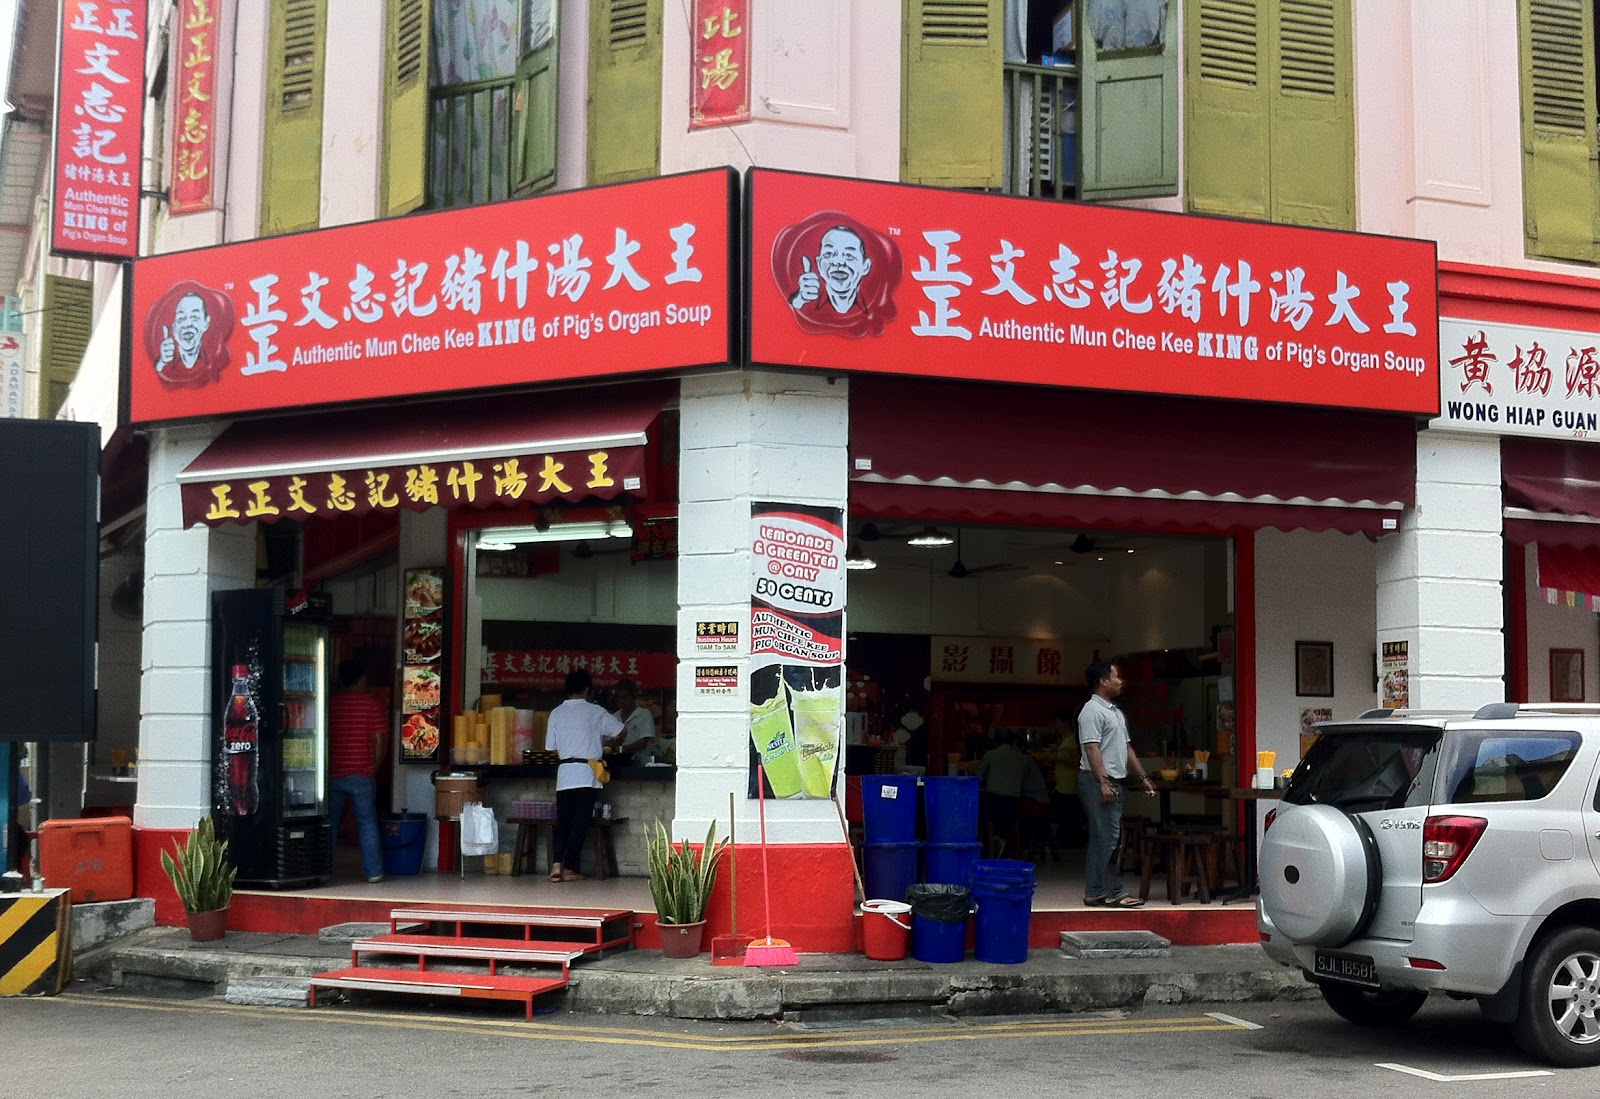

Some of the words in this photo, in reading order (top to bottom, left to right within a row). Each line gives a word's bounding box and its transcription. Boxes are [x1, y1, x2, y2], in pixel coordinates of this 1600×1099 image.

[65, 187, 129, 207] Authentic
[64, 211, 108, 231] KING
[113, 220, 128, 232] of
[292, 341, 362, 366] Authentic
[365, 337, 398, 358] Mun
[401, 332, 440, 354] Chee
[444, 328, 475, 349] Kee
[477, 316, 537, 347] KING
[542, 317, 560, 339] of
[564, 313, 604, 340] Pig's
[608, 309, 660, 335] Organ
[665, 303, 712, 327] Soup
[978, 316, 1065, 344] Authentic
[1070, 324, 1107, 347] Mun
[1112, 327, 1156, 351] Chee
[1161, 331, 1194, 354] Kee
[1197, 332, 1258, 361] KING
[1265, 341, 1283, 361] of
[1286, 342, 1327, 368] Pig's
[1330, 346, 1379, 372] Organ
[1384, 350, 1426, 377] Soup
[1448, 401, 1499, 423] WONG
[1506, 406, 1545, 426] HIAP
[1552, 410, 1597, 431] GUAN
[205, 452, 615, 520] 正正文志記豬什湯大王
[761, 525, 833, 553] LEMONADE
[753, 540, 765, 555] &
[767, 544, 811, 565] GREEN
[811, 552, 838, 569] TEA
[768, 560, 781, 574] @
[782, 563, 820, 582] ONLY
[756, 577, 777, 596] 50
[754, 613, 812, 639] AUTHENTIC
[754, 626, 776, 637] MUN
[777, 631, 804, 645] CHEE
[806, 641, 828, 651] KEE
[755, 639, 772, 650] PIG
[774, 640, 809, 657] ORGAN
[811, 651, 839, 659] SOUP
[230, 742, 251, 750] zero
